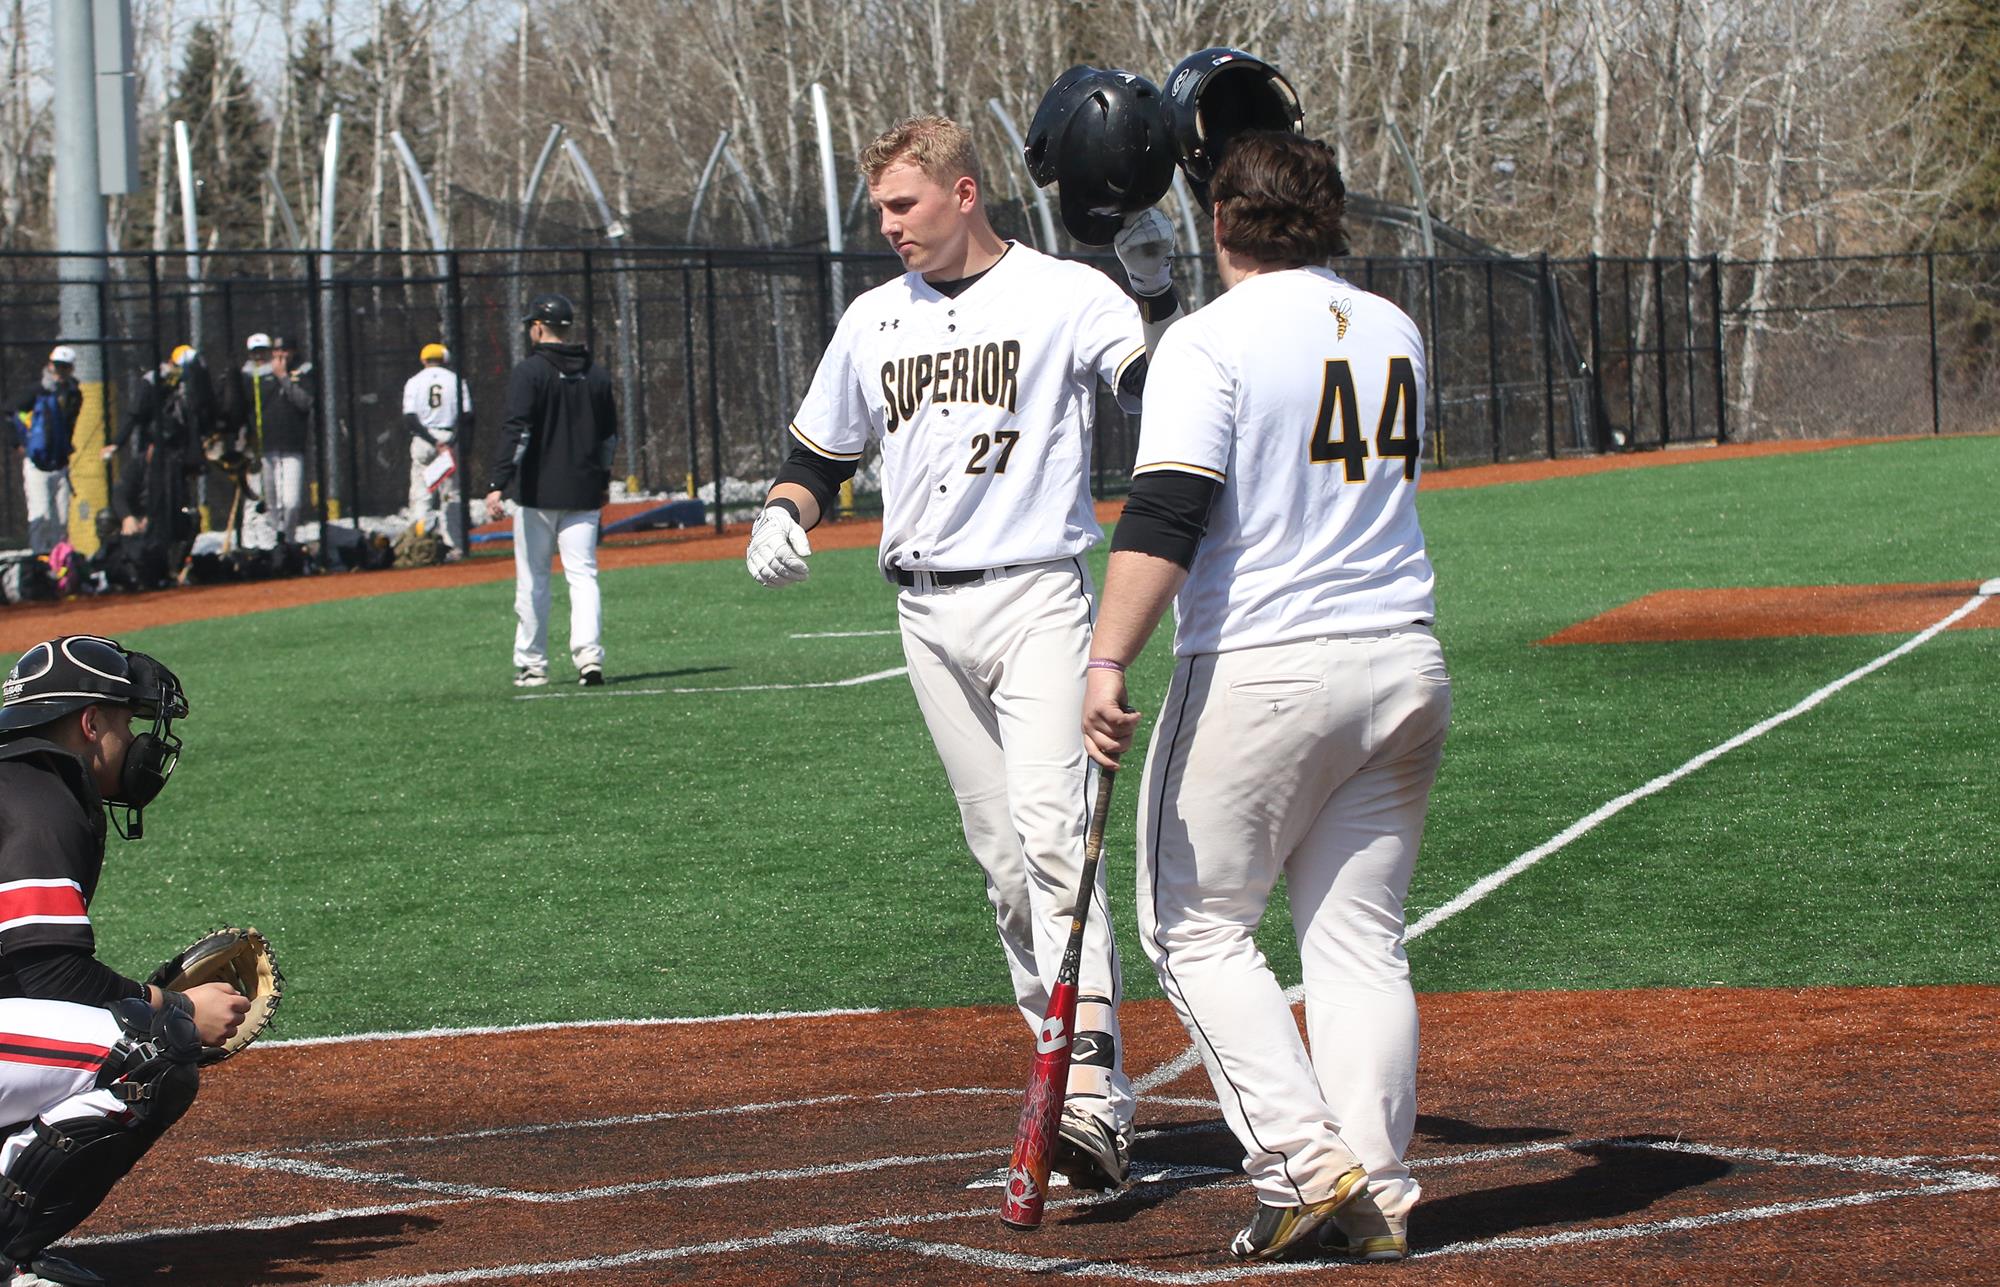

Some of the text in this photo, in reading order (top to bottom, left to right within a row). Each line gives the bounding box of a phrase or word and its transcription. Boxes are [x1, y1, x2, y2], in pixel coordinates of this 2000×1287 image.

[428, 384, 442, 409] 6
[881, 340, 1021, 433] SUPERIOR
[1309, 355, 1420, 484] 44
[964, 430, 1020, 475] 27
